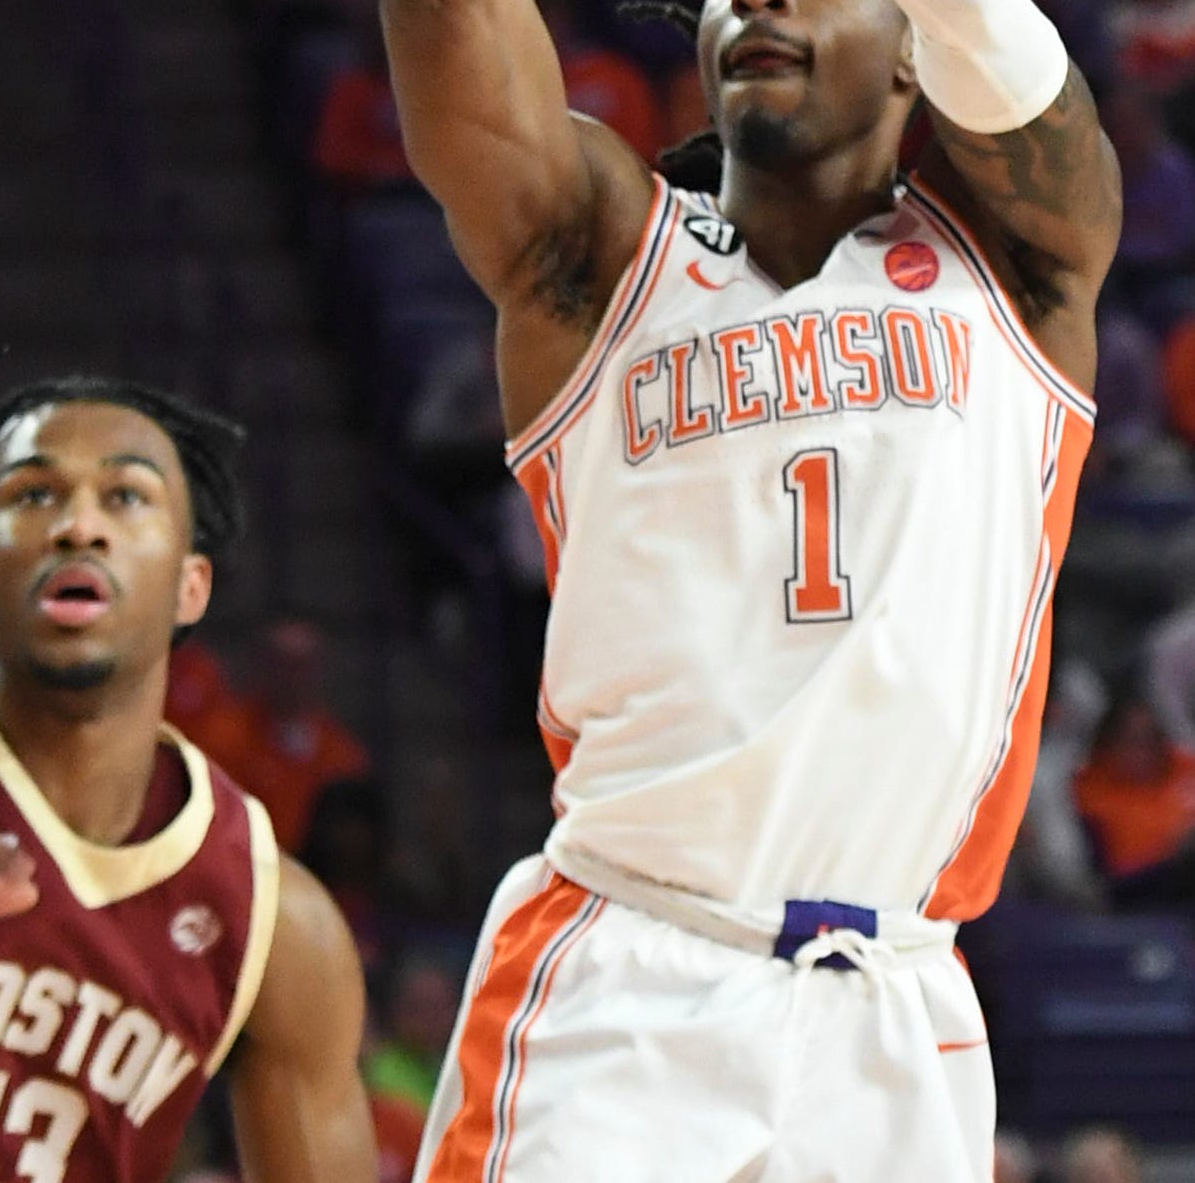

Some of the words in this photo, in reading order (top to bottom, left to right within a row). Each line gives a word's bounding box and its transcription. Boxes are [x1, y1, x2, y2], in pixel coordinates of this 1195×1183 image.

[687, 219, 736, 253] 41
[621, 305, 974, 466] CLEMSON
[782, 447, 853, 624] 1
